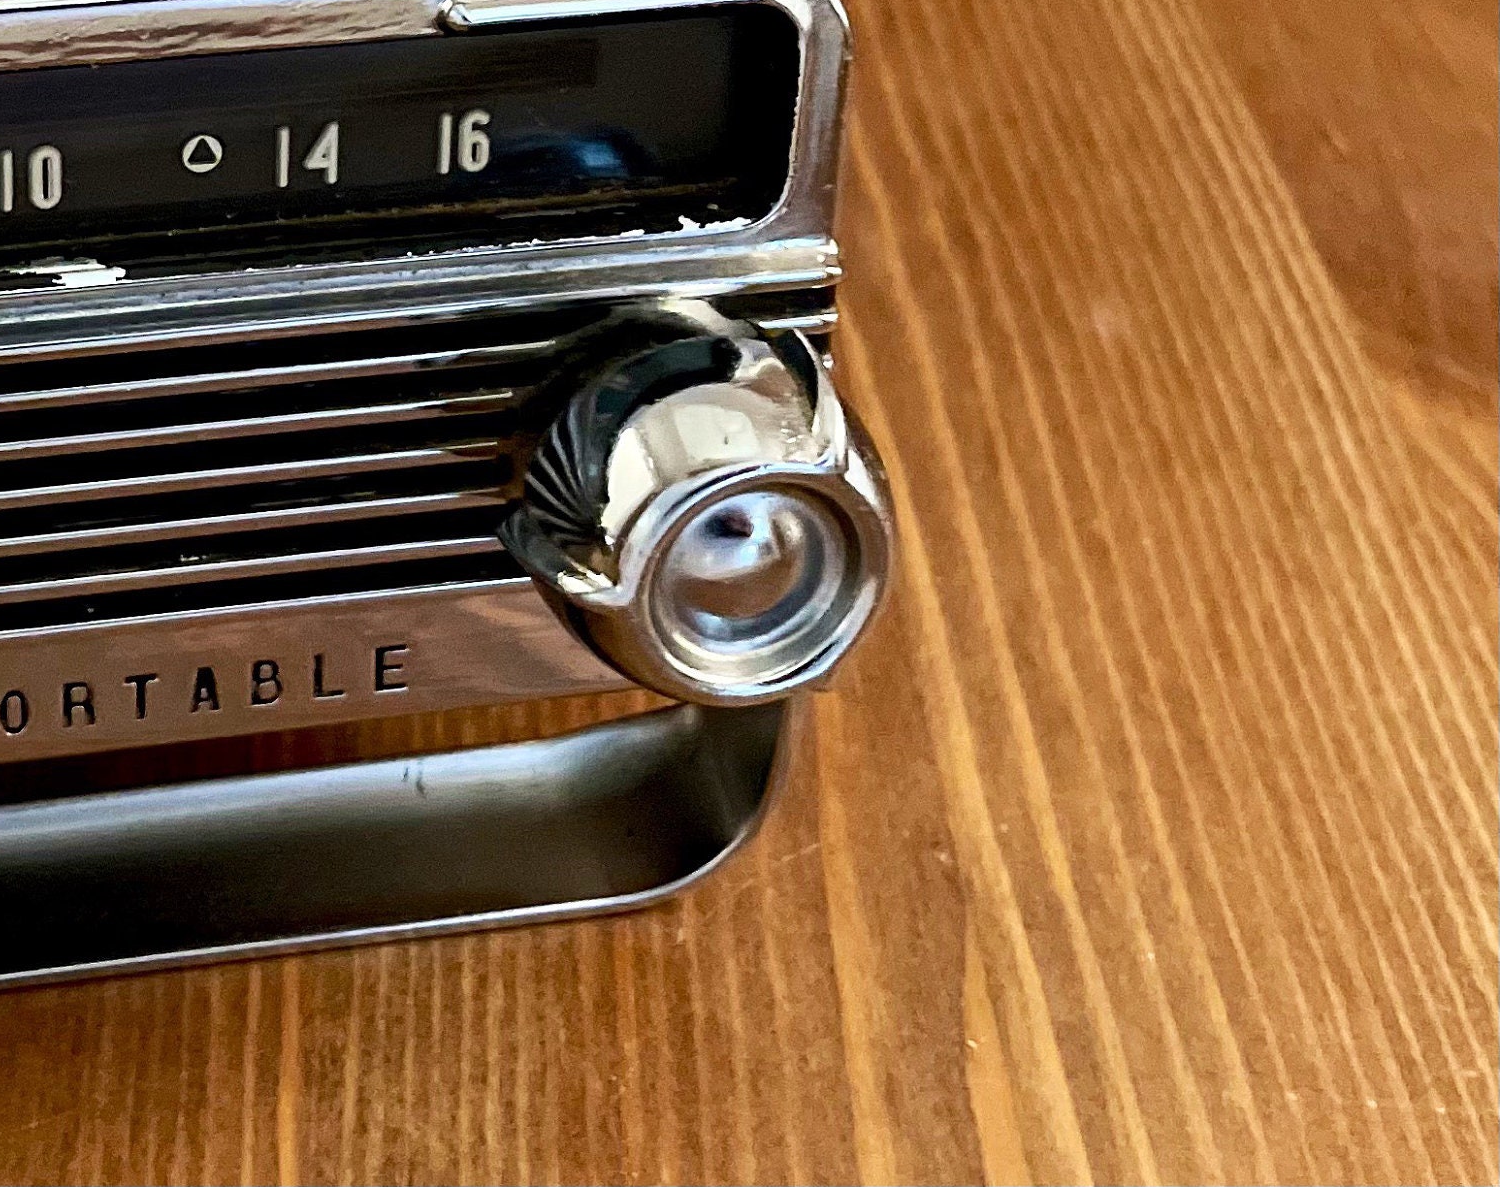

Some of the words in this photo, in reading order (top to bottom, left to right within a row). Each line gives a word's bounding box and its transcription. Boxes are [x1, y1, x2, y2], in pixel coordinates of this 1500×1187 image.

[1, 144, 64, 214] 10
[275, 121, 340, 189] 14
[435, 110, 492, 176] 16
